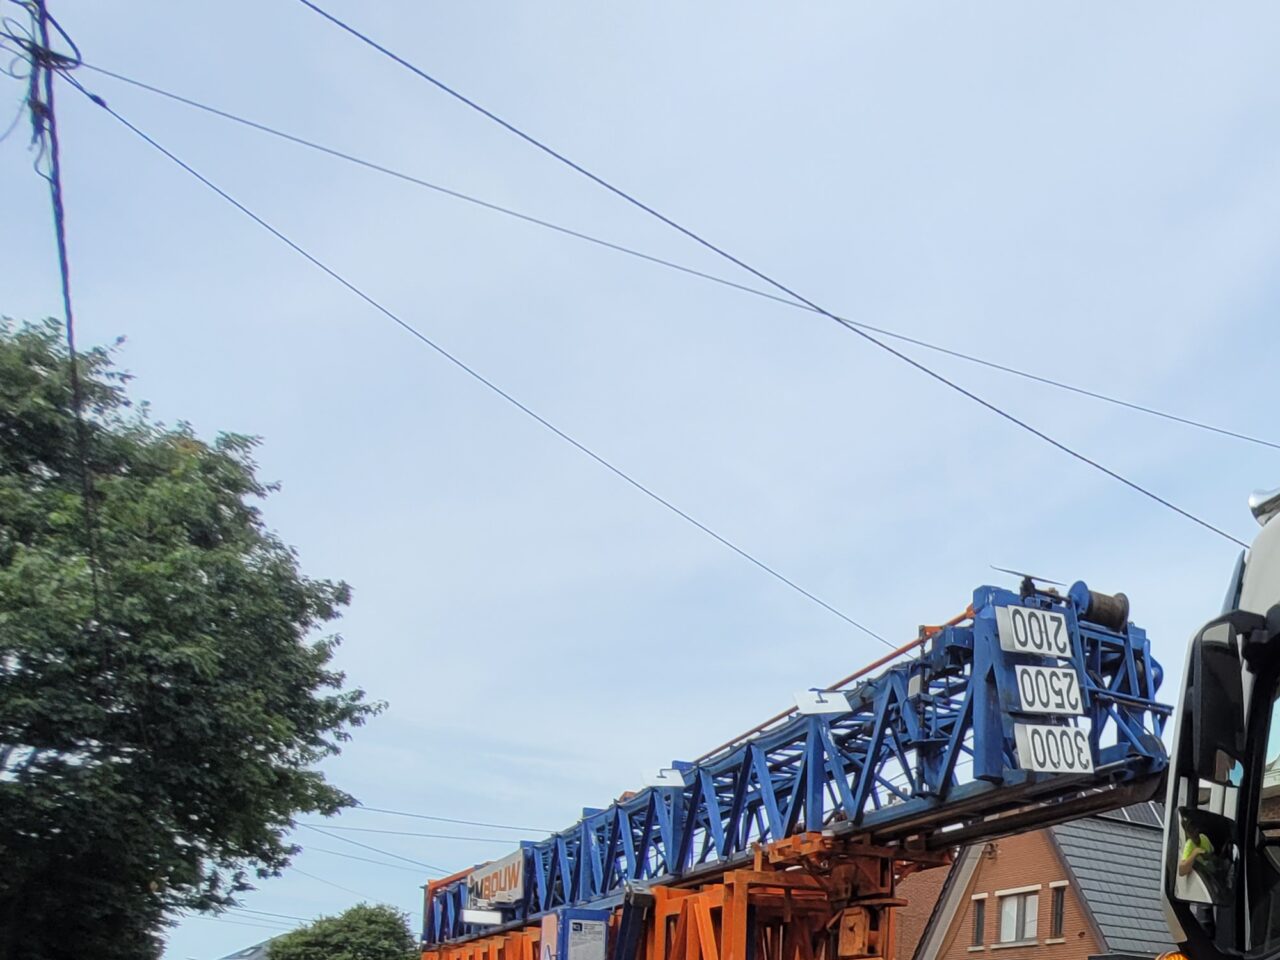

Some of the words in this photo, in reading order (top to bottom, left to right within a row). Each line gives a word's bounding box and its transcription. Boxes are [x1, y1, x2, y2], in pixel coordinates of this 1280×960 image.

[1012, 608, 1067, 654] 2100
[1020, 668, 1079, 710] 2500
[1030, 728, 1090, 770] 3000
